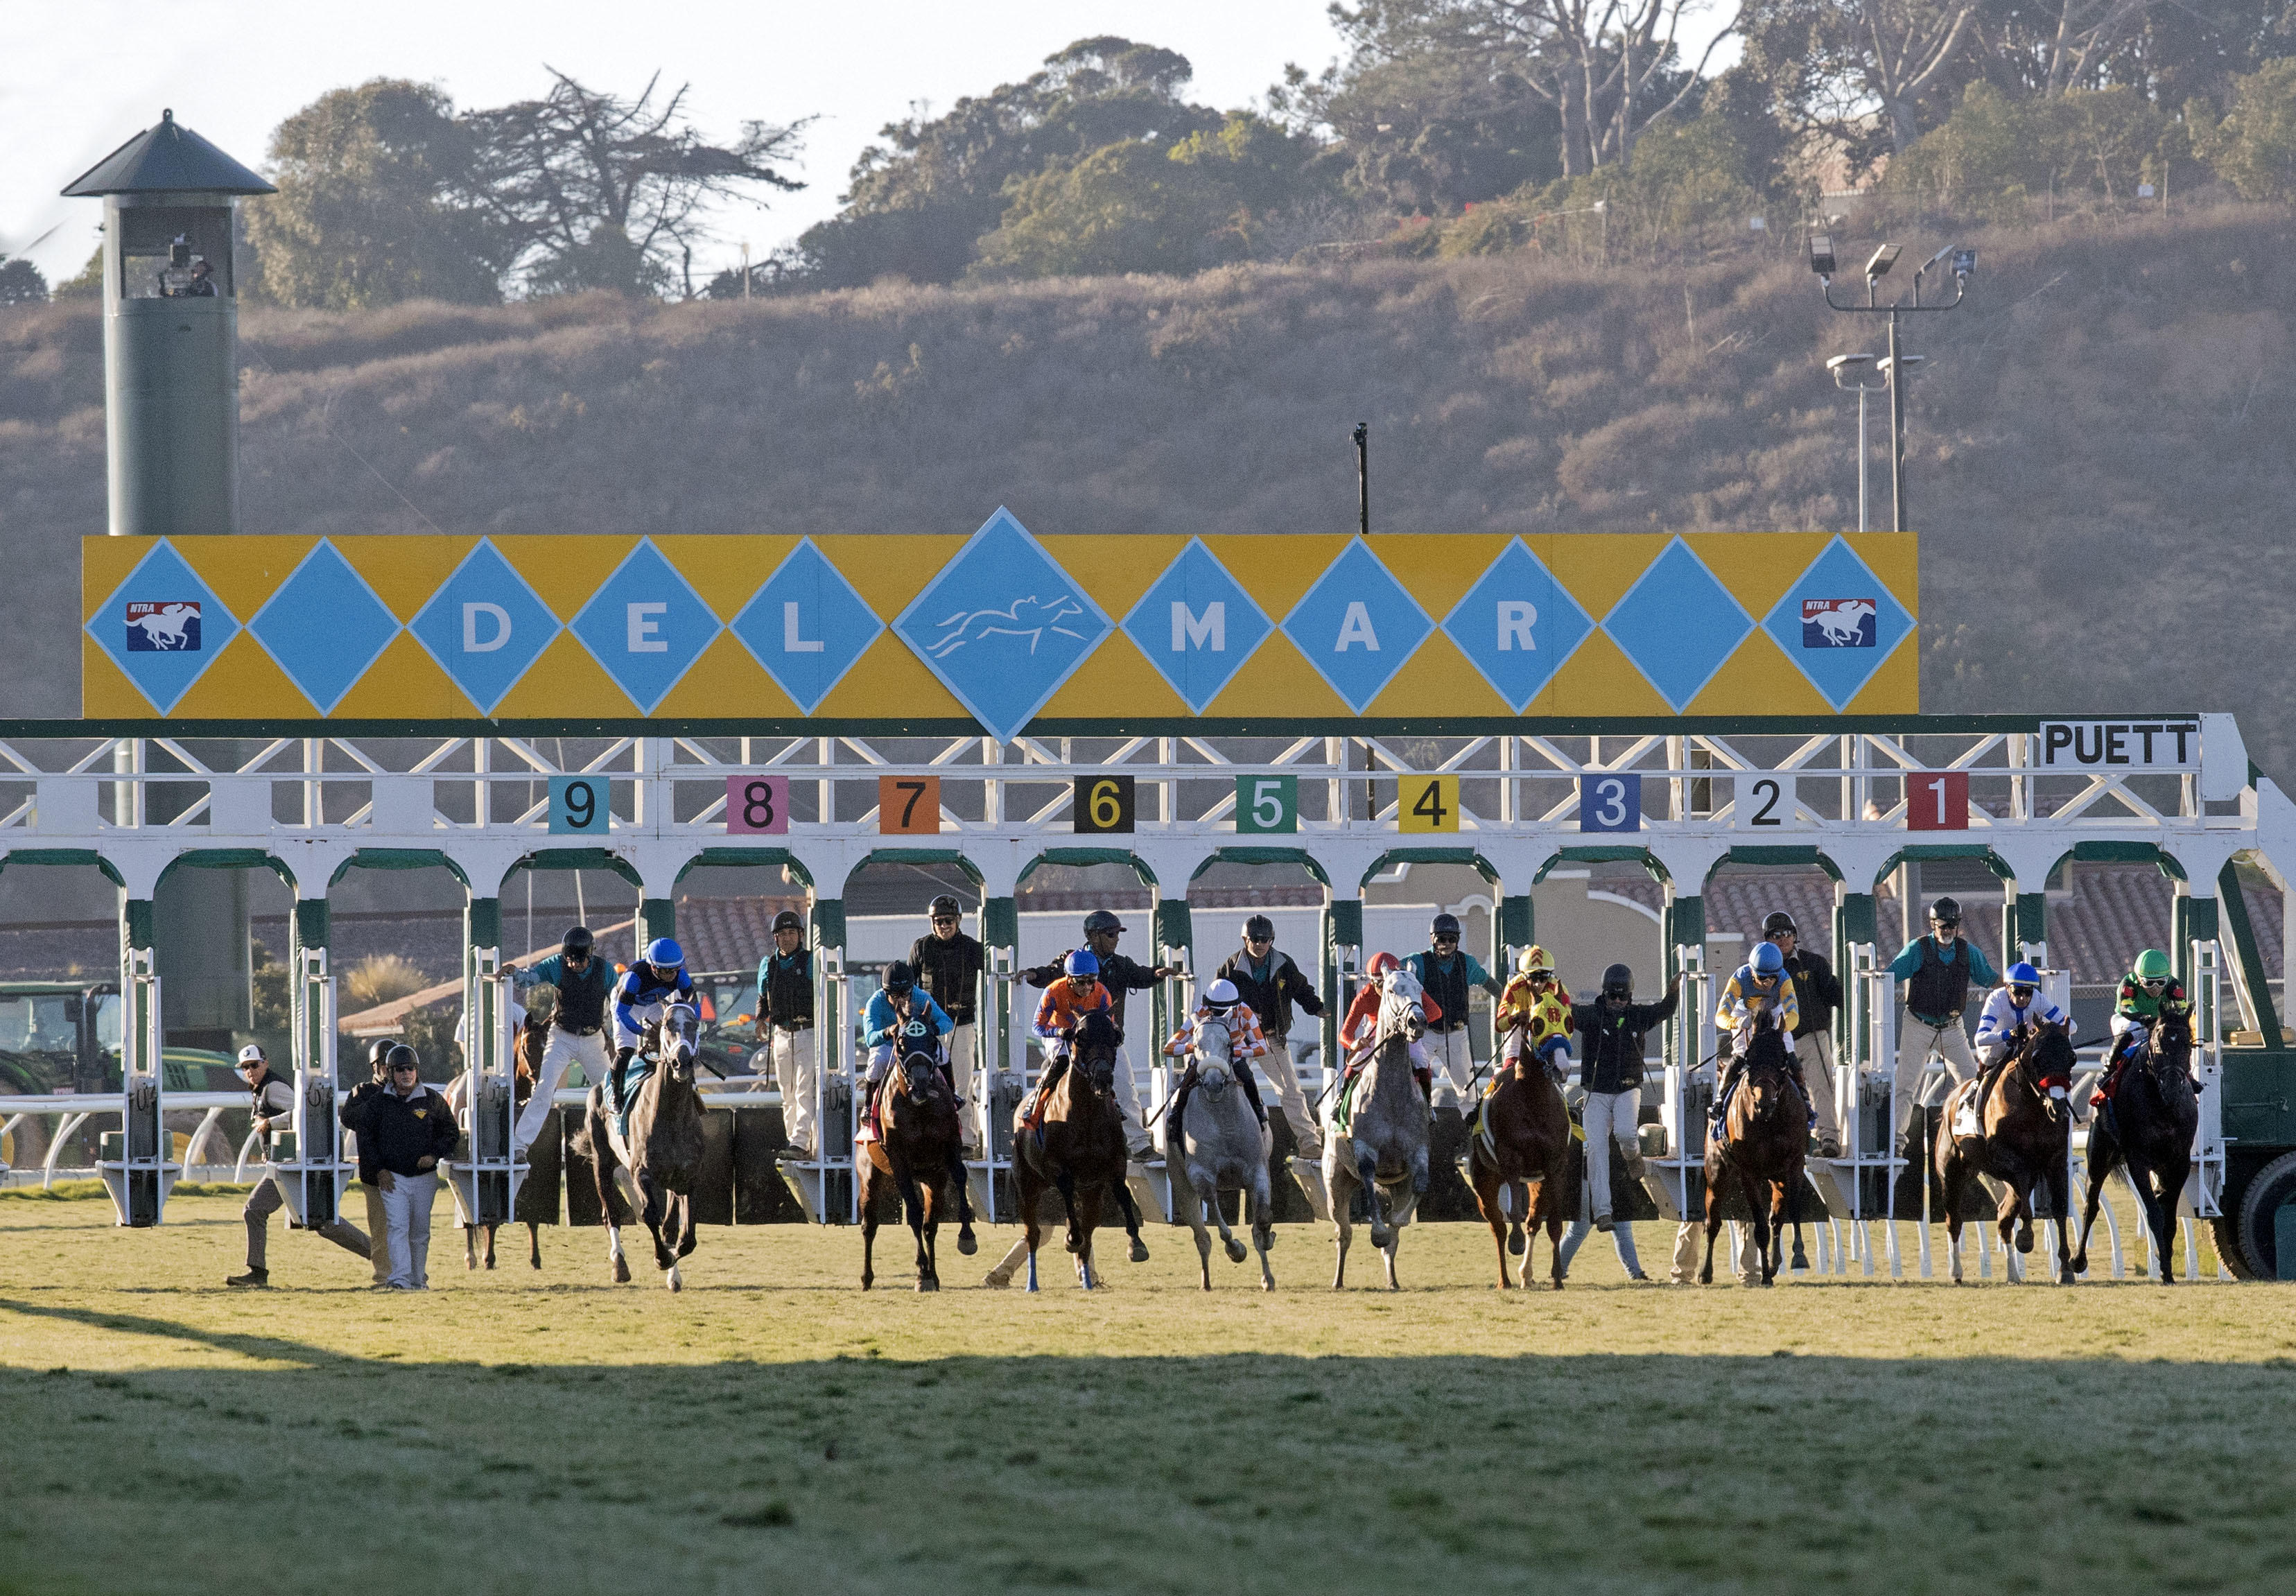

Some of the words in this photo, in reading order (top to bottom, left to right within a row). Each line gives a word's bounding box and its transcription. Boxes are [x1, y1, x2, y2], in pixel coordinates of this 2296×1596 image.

[130, 603, 155, 613] NTRA
[463, 602, 824, 652] DEL
[1171, 600, 1538, 652] MAR
[1806, 600, 1830, 610] NTRA
[2046, 723, 2198, 764] PUETT
[565, 781, 595, 829] 9
[744, 781, 774, 828] 8
[896, 782, 925, 828] 7
[1090, 781, 1120, 828] 6
[1253, 781, 1283, 828] 5
[1414, 781, 1447, 826] 4
[1596, 779, 1626, 826] 3
[1751, 779, 1781, 826] 2
[1928, 777, 1945, 824] 1
